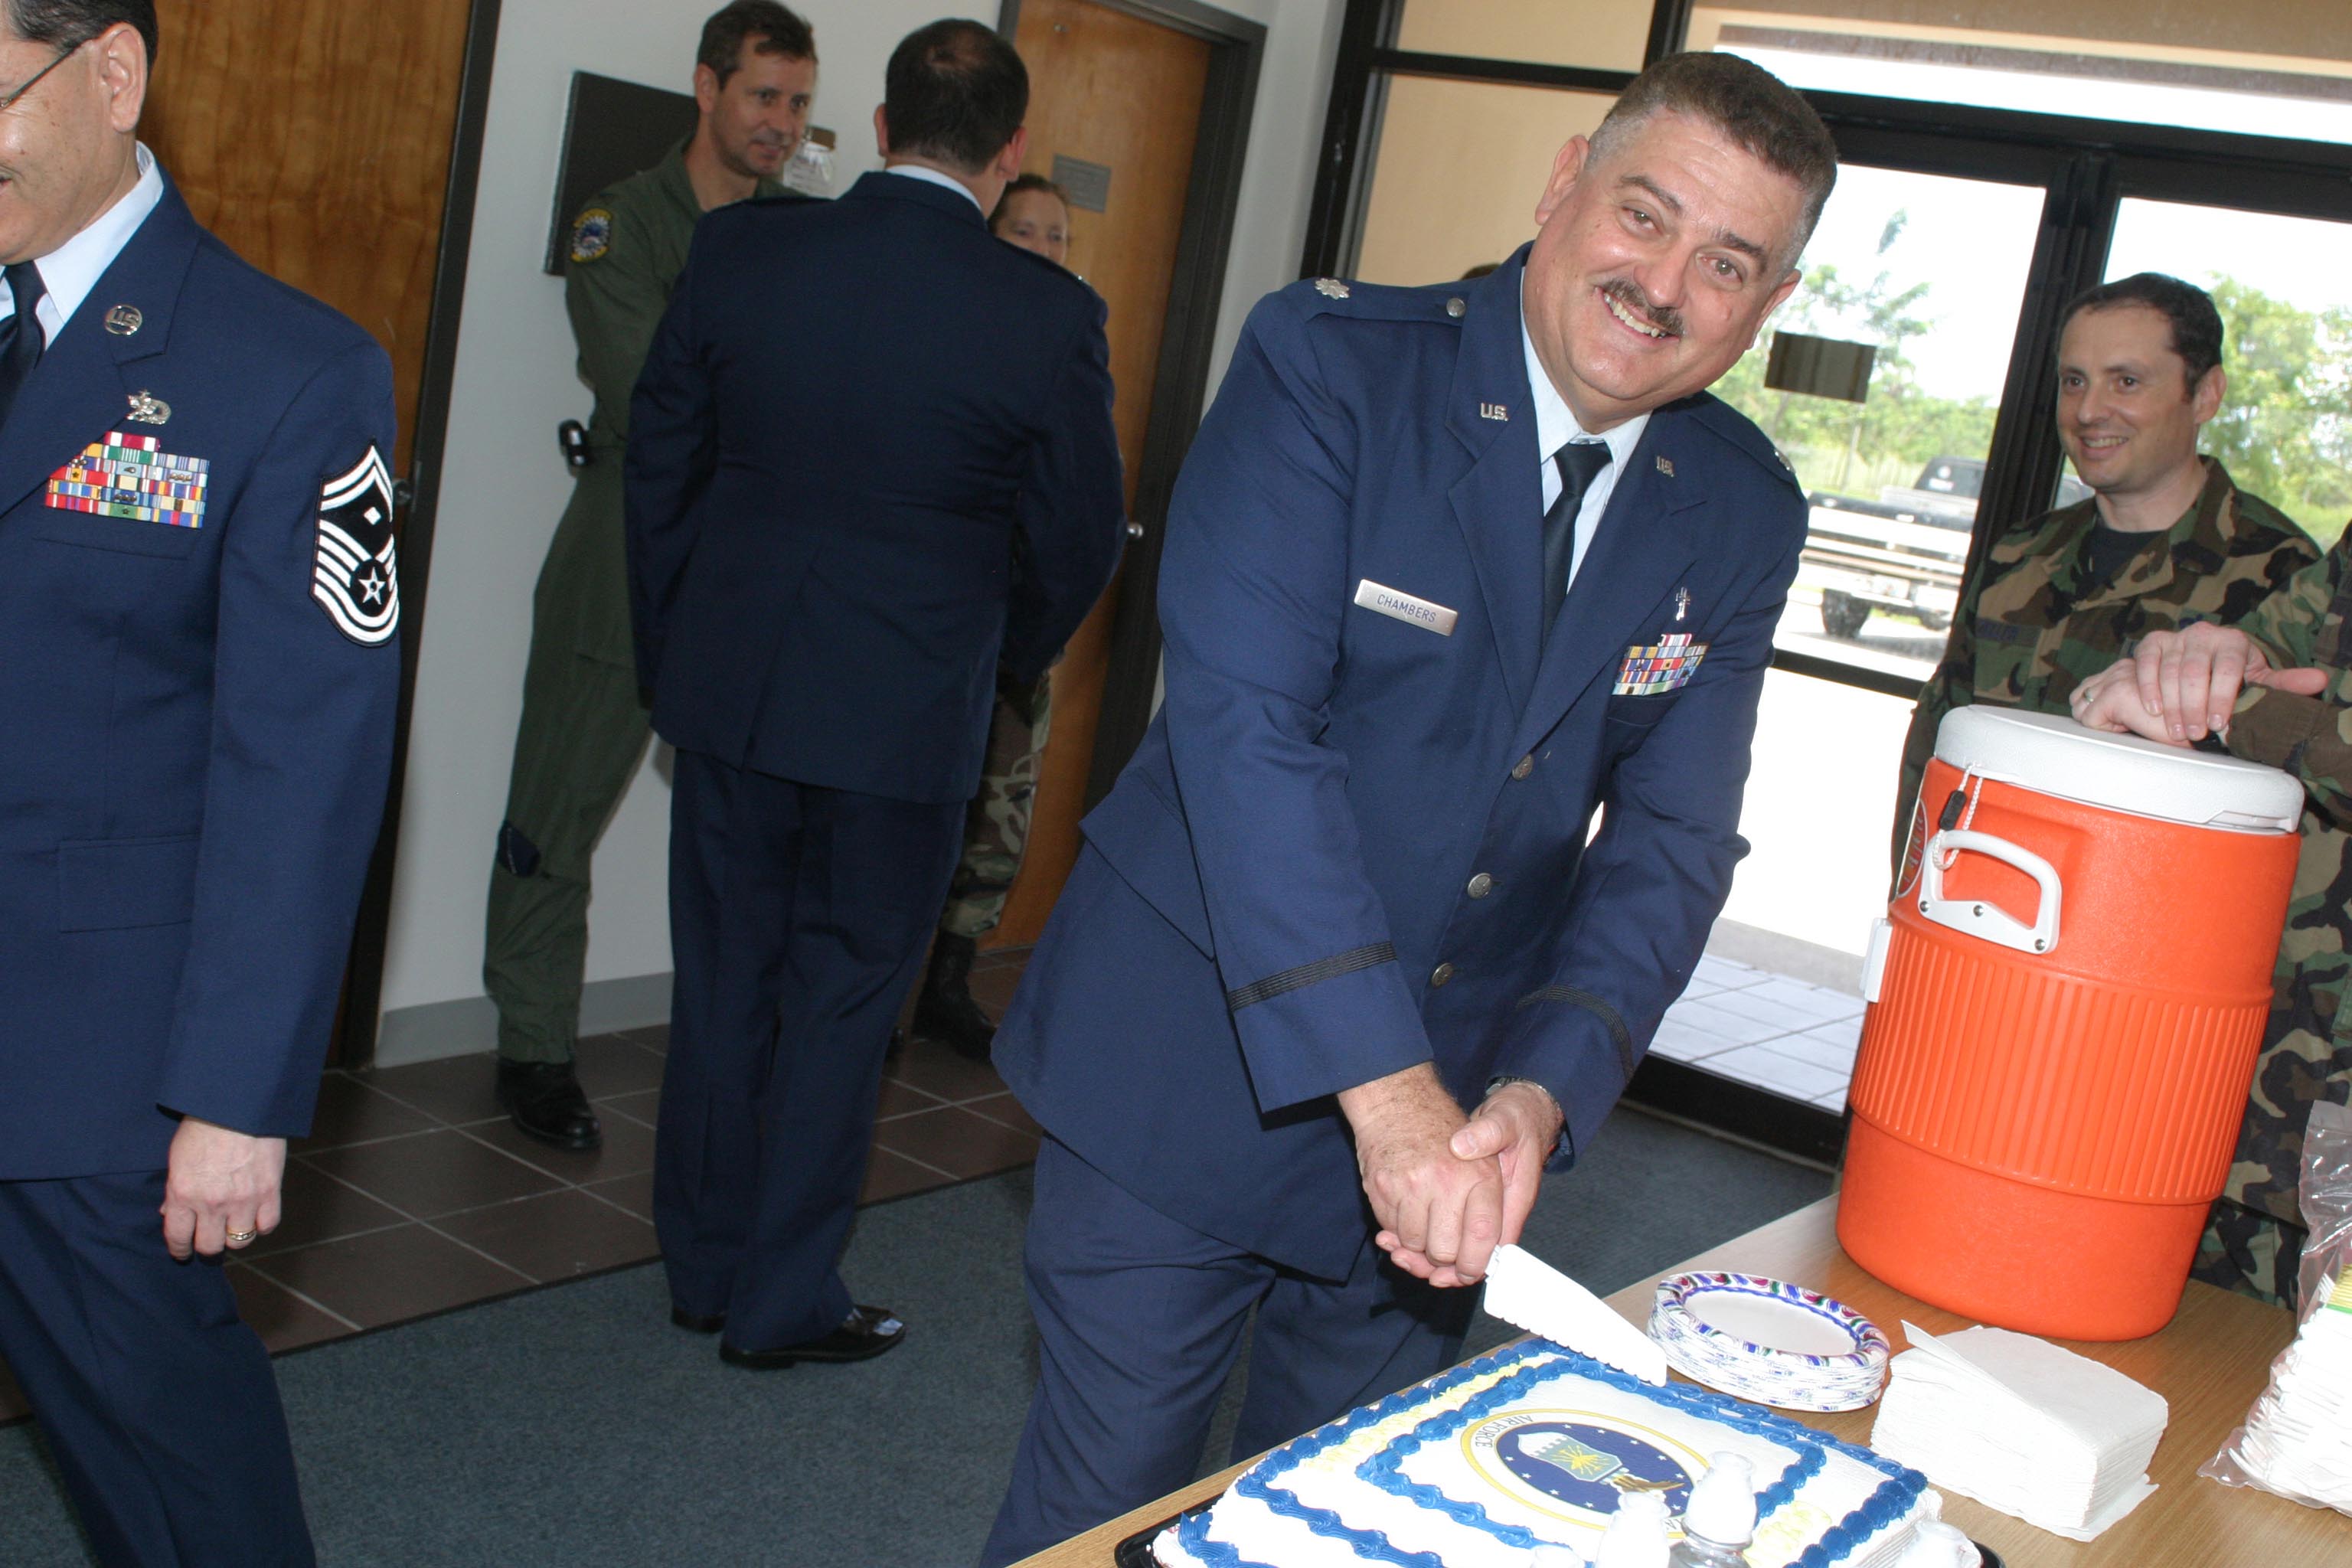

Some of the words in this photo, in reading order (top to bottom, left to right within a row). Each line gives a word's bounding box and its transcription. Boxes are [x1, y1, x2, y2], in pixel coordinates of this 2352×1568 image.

[1377, 593, 1436, 623] CHAMBERS
[1500, 1414, 1534, 1426] AIR
[1475, 1421, 1508, 1449] FORCE
